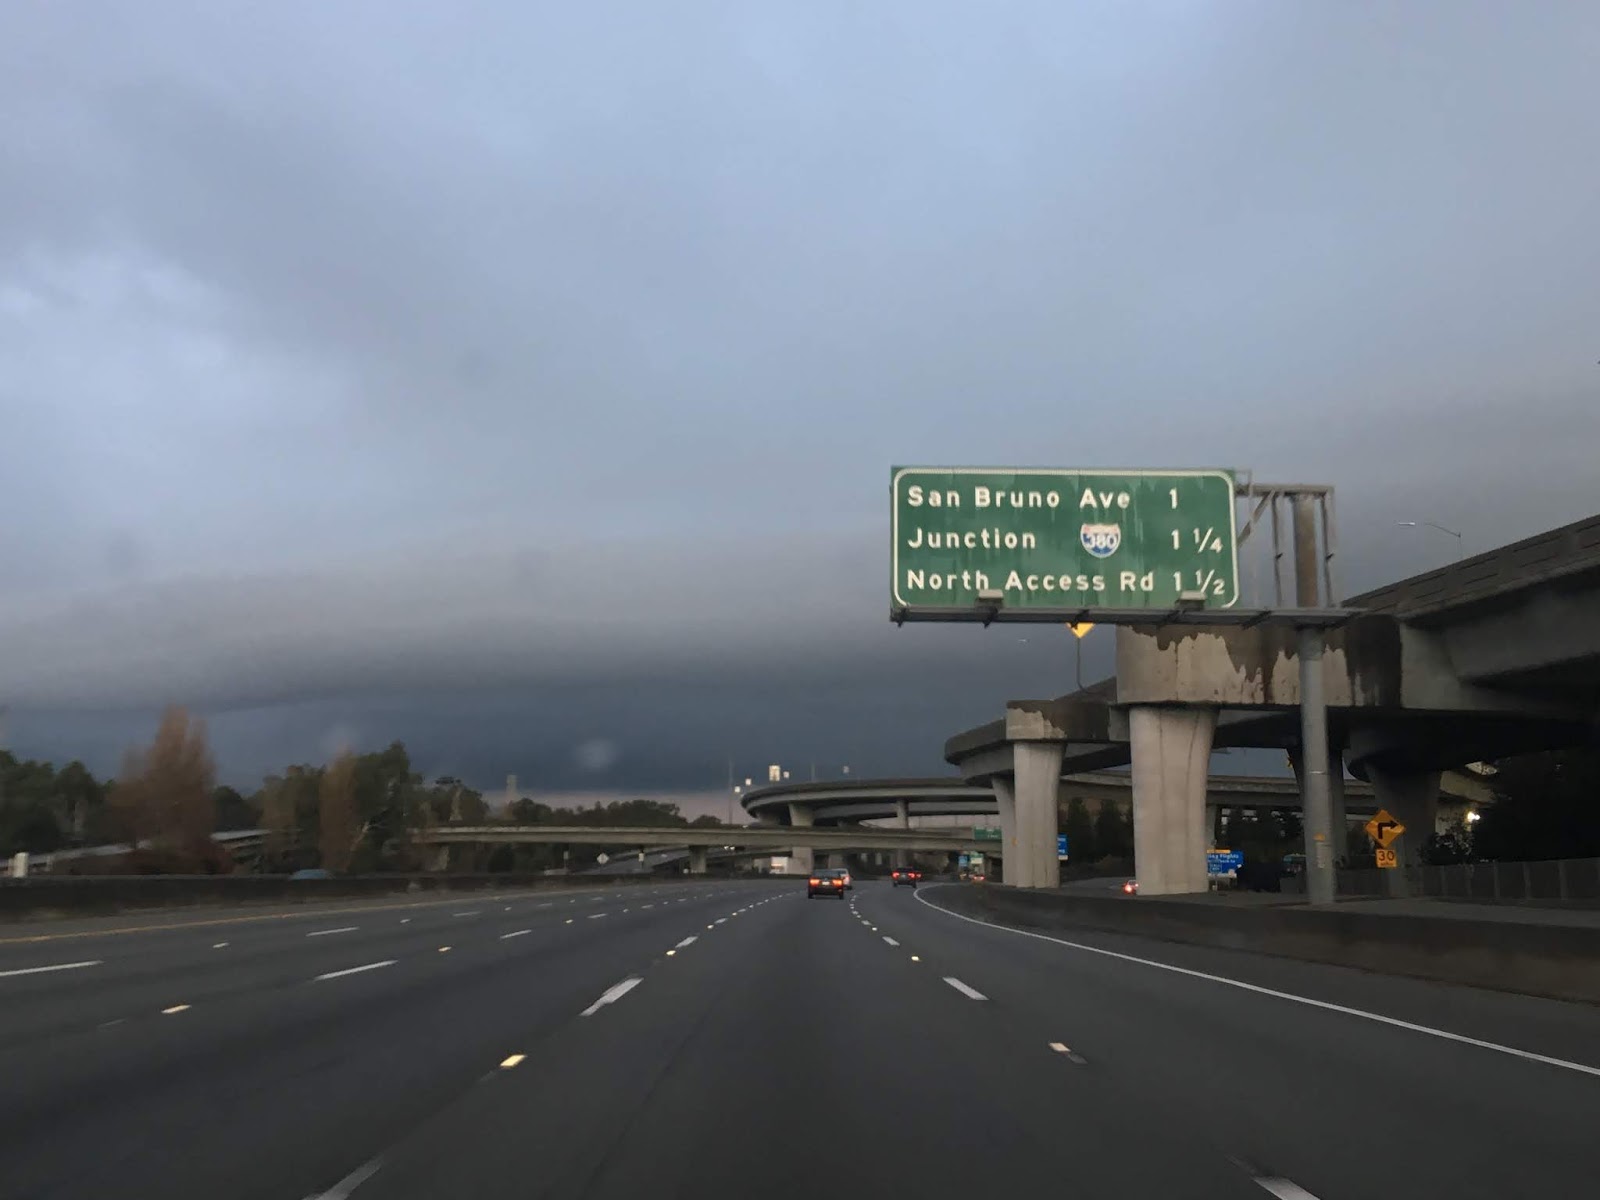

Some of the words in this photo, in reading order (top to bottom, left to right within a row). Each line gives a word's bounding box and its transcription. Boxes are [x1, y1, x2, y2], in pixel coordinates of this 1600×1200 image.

[908, 486, 961, 507] San
[975, 486, 1060, 508] Bruno
[1080, 488, 1131, 509] Ave
[1169, 488, 1178, 509] 1
[908, 528, 1036, 549] Junction
[1171, 530, 1179, 550] 1
[1086, 532, 1115, 546] 380
[907, 570, 989, 591] North
[1004, 571, 1105, 592] Access
[1120, 571, 1154, 592] Rd
[1173, 572, 1181, 592] 1
[1378, 850, 1395, 861] 30
